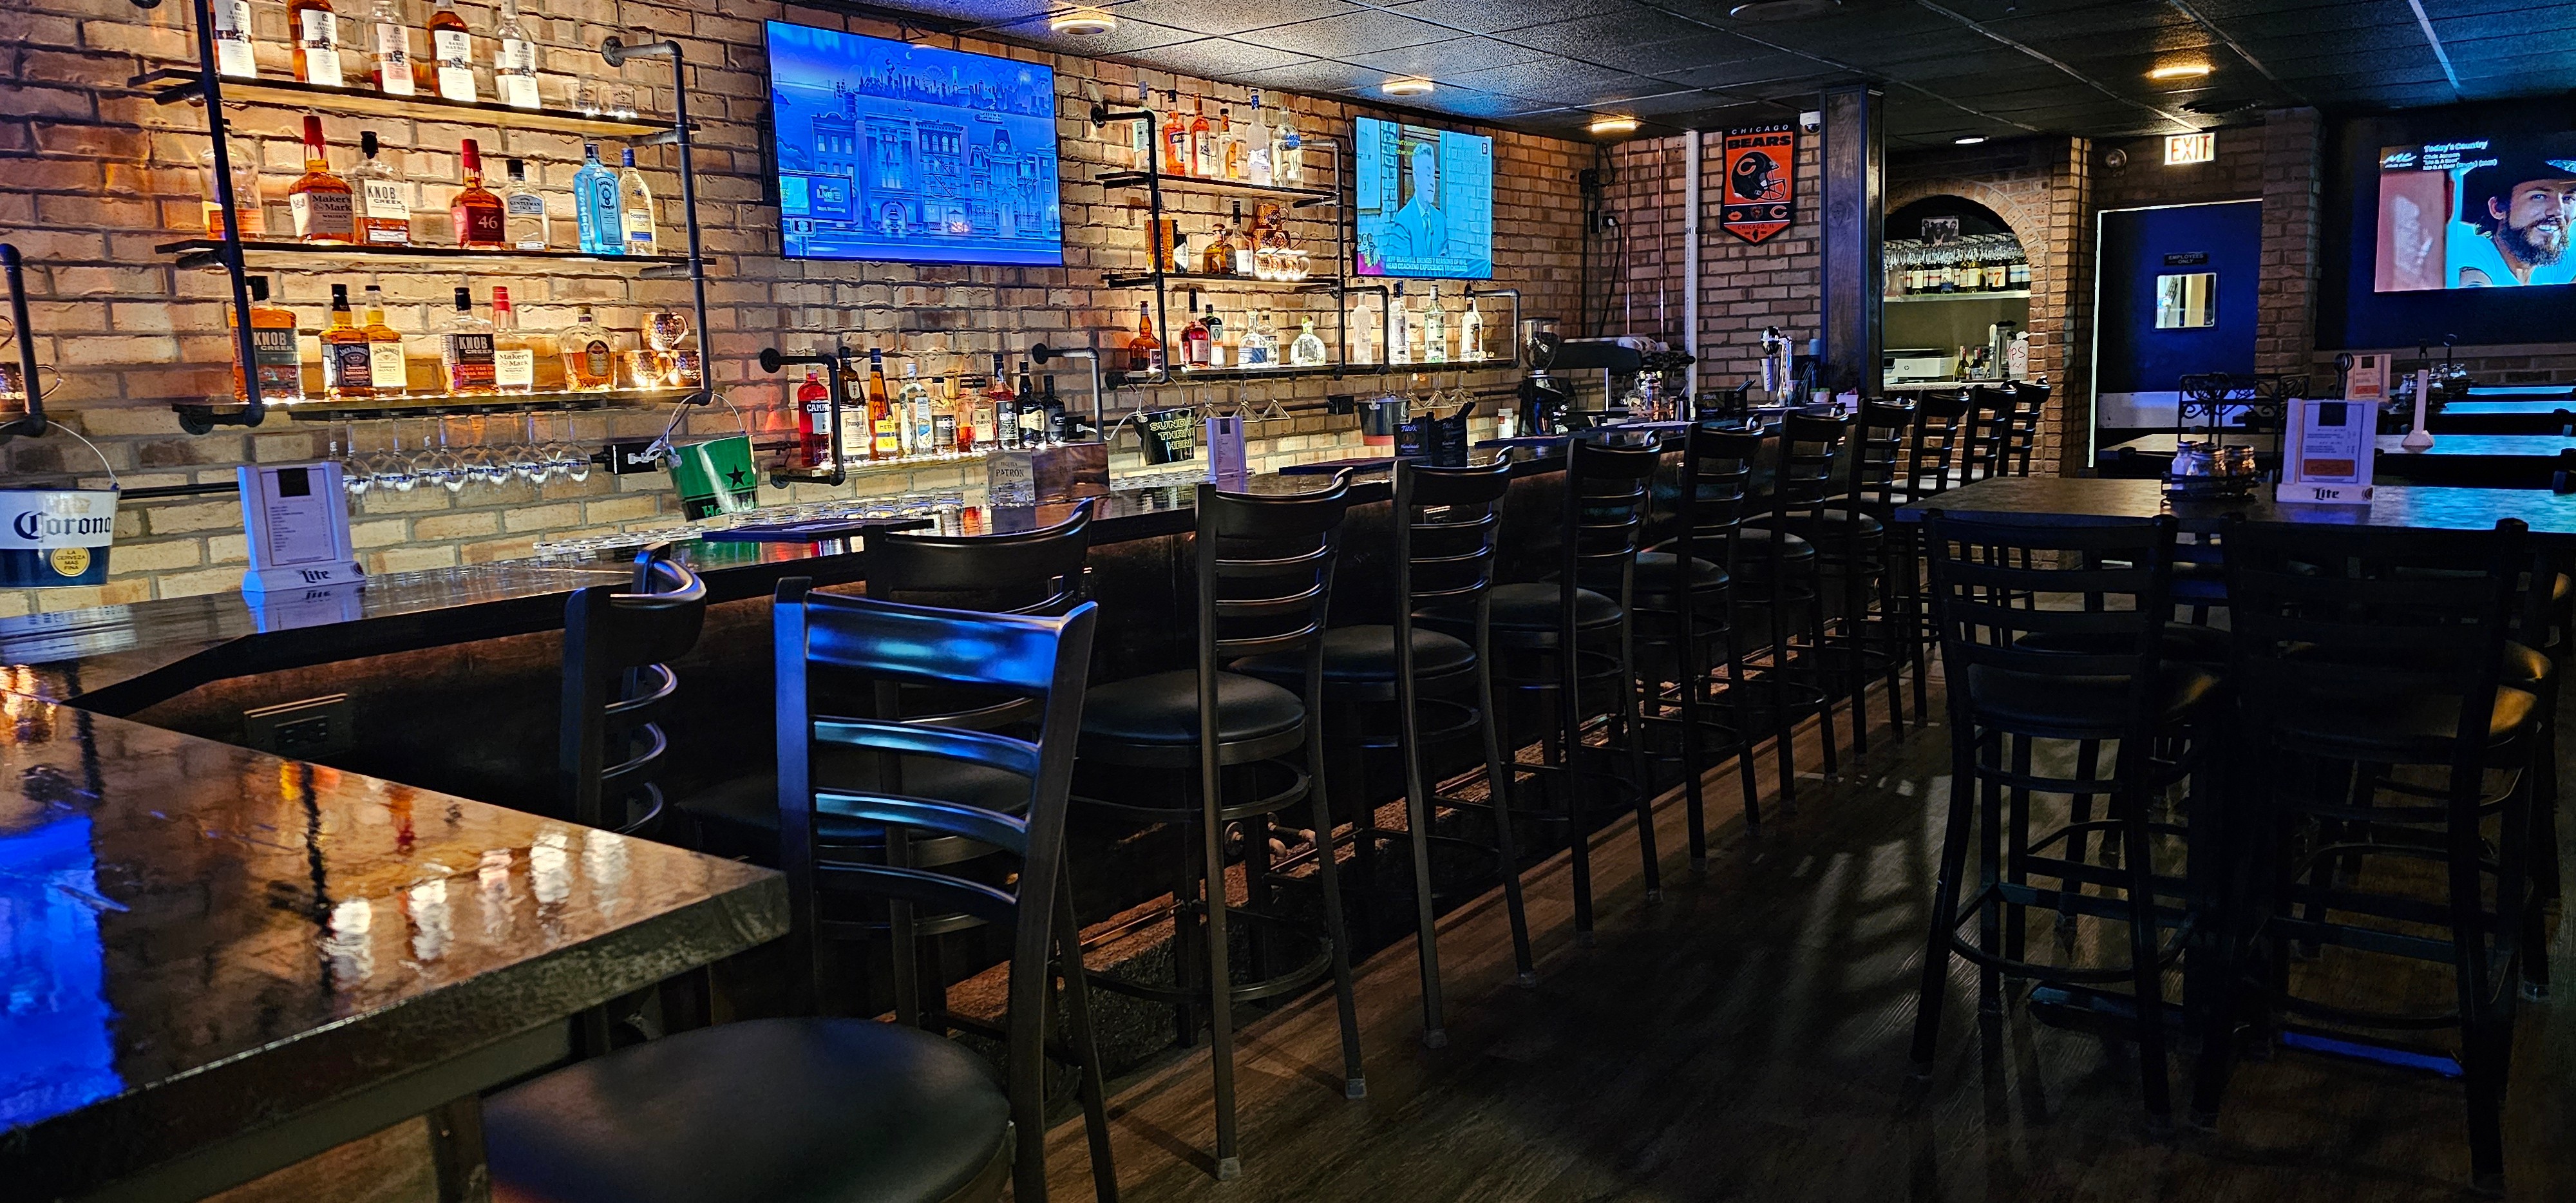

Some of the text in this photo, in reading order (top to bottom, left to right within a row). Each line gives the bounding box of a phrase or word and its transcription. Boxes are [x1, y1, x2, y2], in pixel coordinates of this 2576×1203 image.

[1732, 124, 1788, 135] CHICAGO
[1727, 135, 1791, 150] BEARS
[2171, 135, 2210, 162] EXIT
[2424, 140, 2488, 153] Today's Country
[312, 194, 352, 204] Maker's
[367, 185, 396, 200] KNOB
[478, 215, 498, 229] 46
[254, 332, 287, 346] KNOB
[459, 337, 488, 350] KNOB
[2313, 487, 2340, 501] Lite
[14, 511, 111, 541] Corona
[300, 569, 332, 583] Lite
